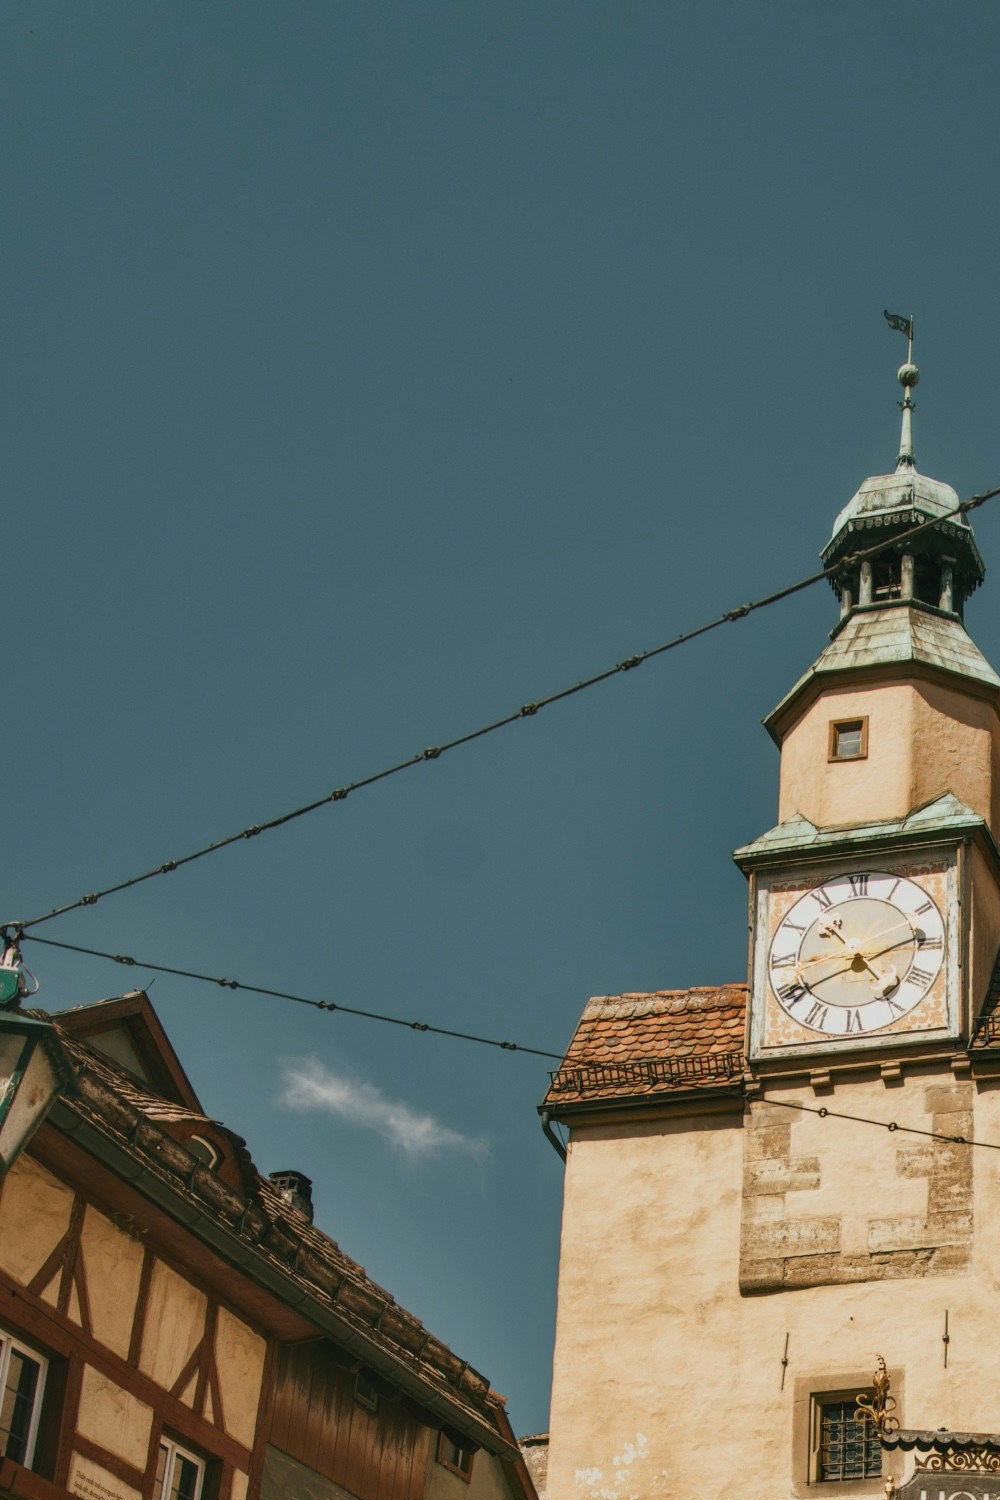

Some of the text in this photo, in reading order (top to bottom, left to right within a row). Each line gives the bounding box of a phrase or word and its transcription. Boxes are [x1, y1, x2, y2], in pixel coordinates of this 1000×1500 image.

[848, 874, 870, 897] XII
[887, 879, 901, 901] I
[811, 886, 833, 912] XI
[915, 900, 934, 916] II
[783, 917, 807, 936] X
[771, 952, 796, 970] IX
[804, 1002, 830, 1029] VII
[886, 996, 906, 1019] V
[845, 1009, 865, 1032] VI
